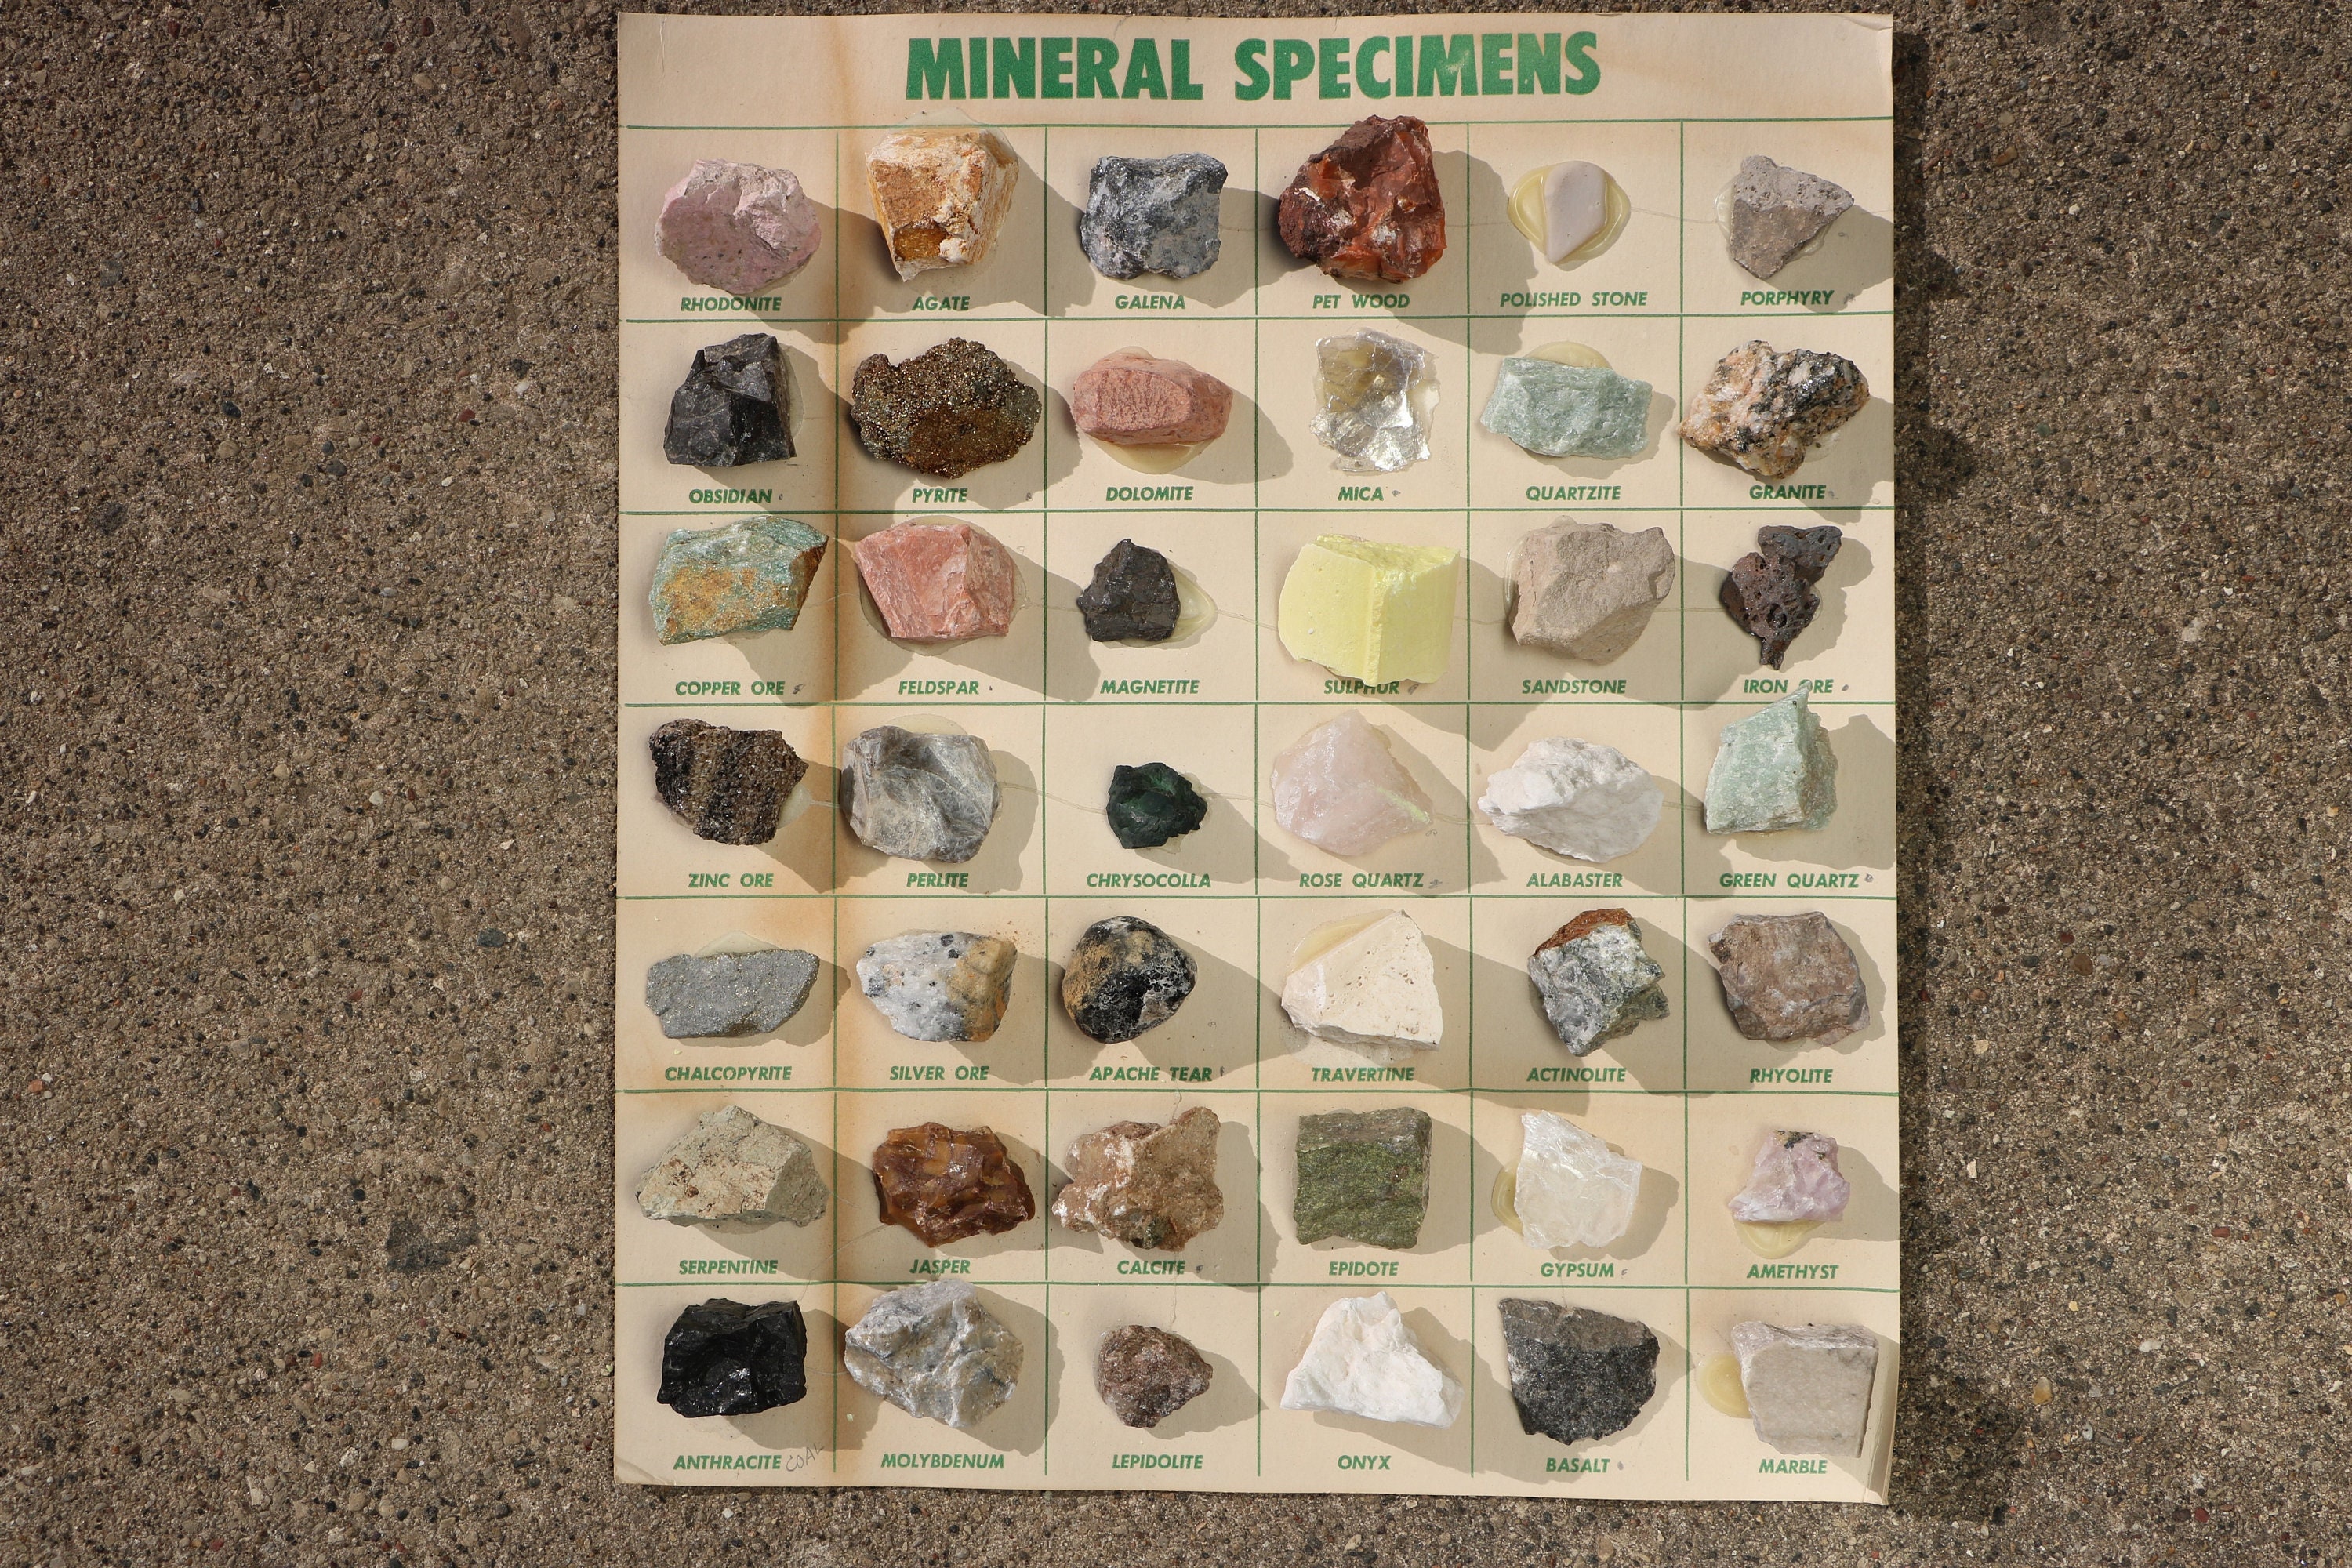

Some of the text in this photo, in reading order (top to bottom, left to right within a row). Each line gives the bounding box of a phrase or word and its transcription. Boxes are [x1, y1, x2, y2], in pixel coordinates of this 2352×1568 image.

[906, 31, 1601, 100] MINERAL SPECIMENS
[682, 297, 780, 311] RHODONITE
[913, 296, 968, 310] AGATE
[1116, 296, 1185, 309] GALENA
[1314, 295, 1410, 308] PET WOOD
[1501, 292, 1646, 307] POLISHED STONE
[1741, 290, 1833, 305] PORPHYRY
[690, 489, 771, 503] OBSIDIAN
[913, 488, 966, 502] PYRITE
[1107, 487, 1192, 501] DOLOMITE
[1339, 487, 1383, 500] MICA
[1526, 486, 1621, 500] QUARTZITE
[1750, 485, 1824, 499] GRANITE
[677, 681, 783, 695] COPPER ORE
[900, 681, 978, 694] FELDSPAR
[1101, 680, 1198, 694] MAGNETITE
[1326, 681, 1398, 693] SULPHUR
[1523, 679, 1624, 694] SANDSTONE
[1744, 679, 1788, 693] IRON
[691, 873, 772, 887] ZINC ORE
[908, 873, 967, 887] PERLITE
[1087, 873, 1210, 887] CHRYSOCOLLA
[1300, 873, 1422, 887] ROSE QUARTZ
[1528, 873, 1622, 887] ALABASTER
[1720, 873, 1859, 887] GREEN QUARTZ
[666, 1066, 790, 1080] CHALCOPYRITE
[892, 1066, 989, 1080] SILVER ORE
[1091, 1066, 1211, 1080] APACHE TEAR
[1313, 1067, 1414, 1081] TRAVERTINE
[1529, 1068, 1625, 1081] ACTINOLITE
[1750, 1069, 1831, 1083] RHYOLITE
[681, 1260, 777, 1274] SERPENTINE
[911, 1260, 970, 1274] JASPER
[1118, 1260, 1184, 1274] CALCITE
[1330, 1261, 1398, 1276] EPIDOTE
[1541, 1262, 1613, 1277] GYPSUM
[1748, 1265, 1838, 1278] AMETHYST
[675, 1455, 781, 1469] ANTHRACITE
[786, 1443, 825, 1472] COAL
[882, 1454, 1004, 1468] MOLYBDENUM
[1112, 1454, 1203, 1469] LEPIDOLITE
[1338, 1455, 1389, 1469] ONYX
[1546, 1457, 1610, 1472] BASALT
[1760, 1460, 1826, 1473] MARBLE
